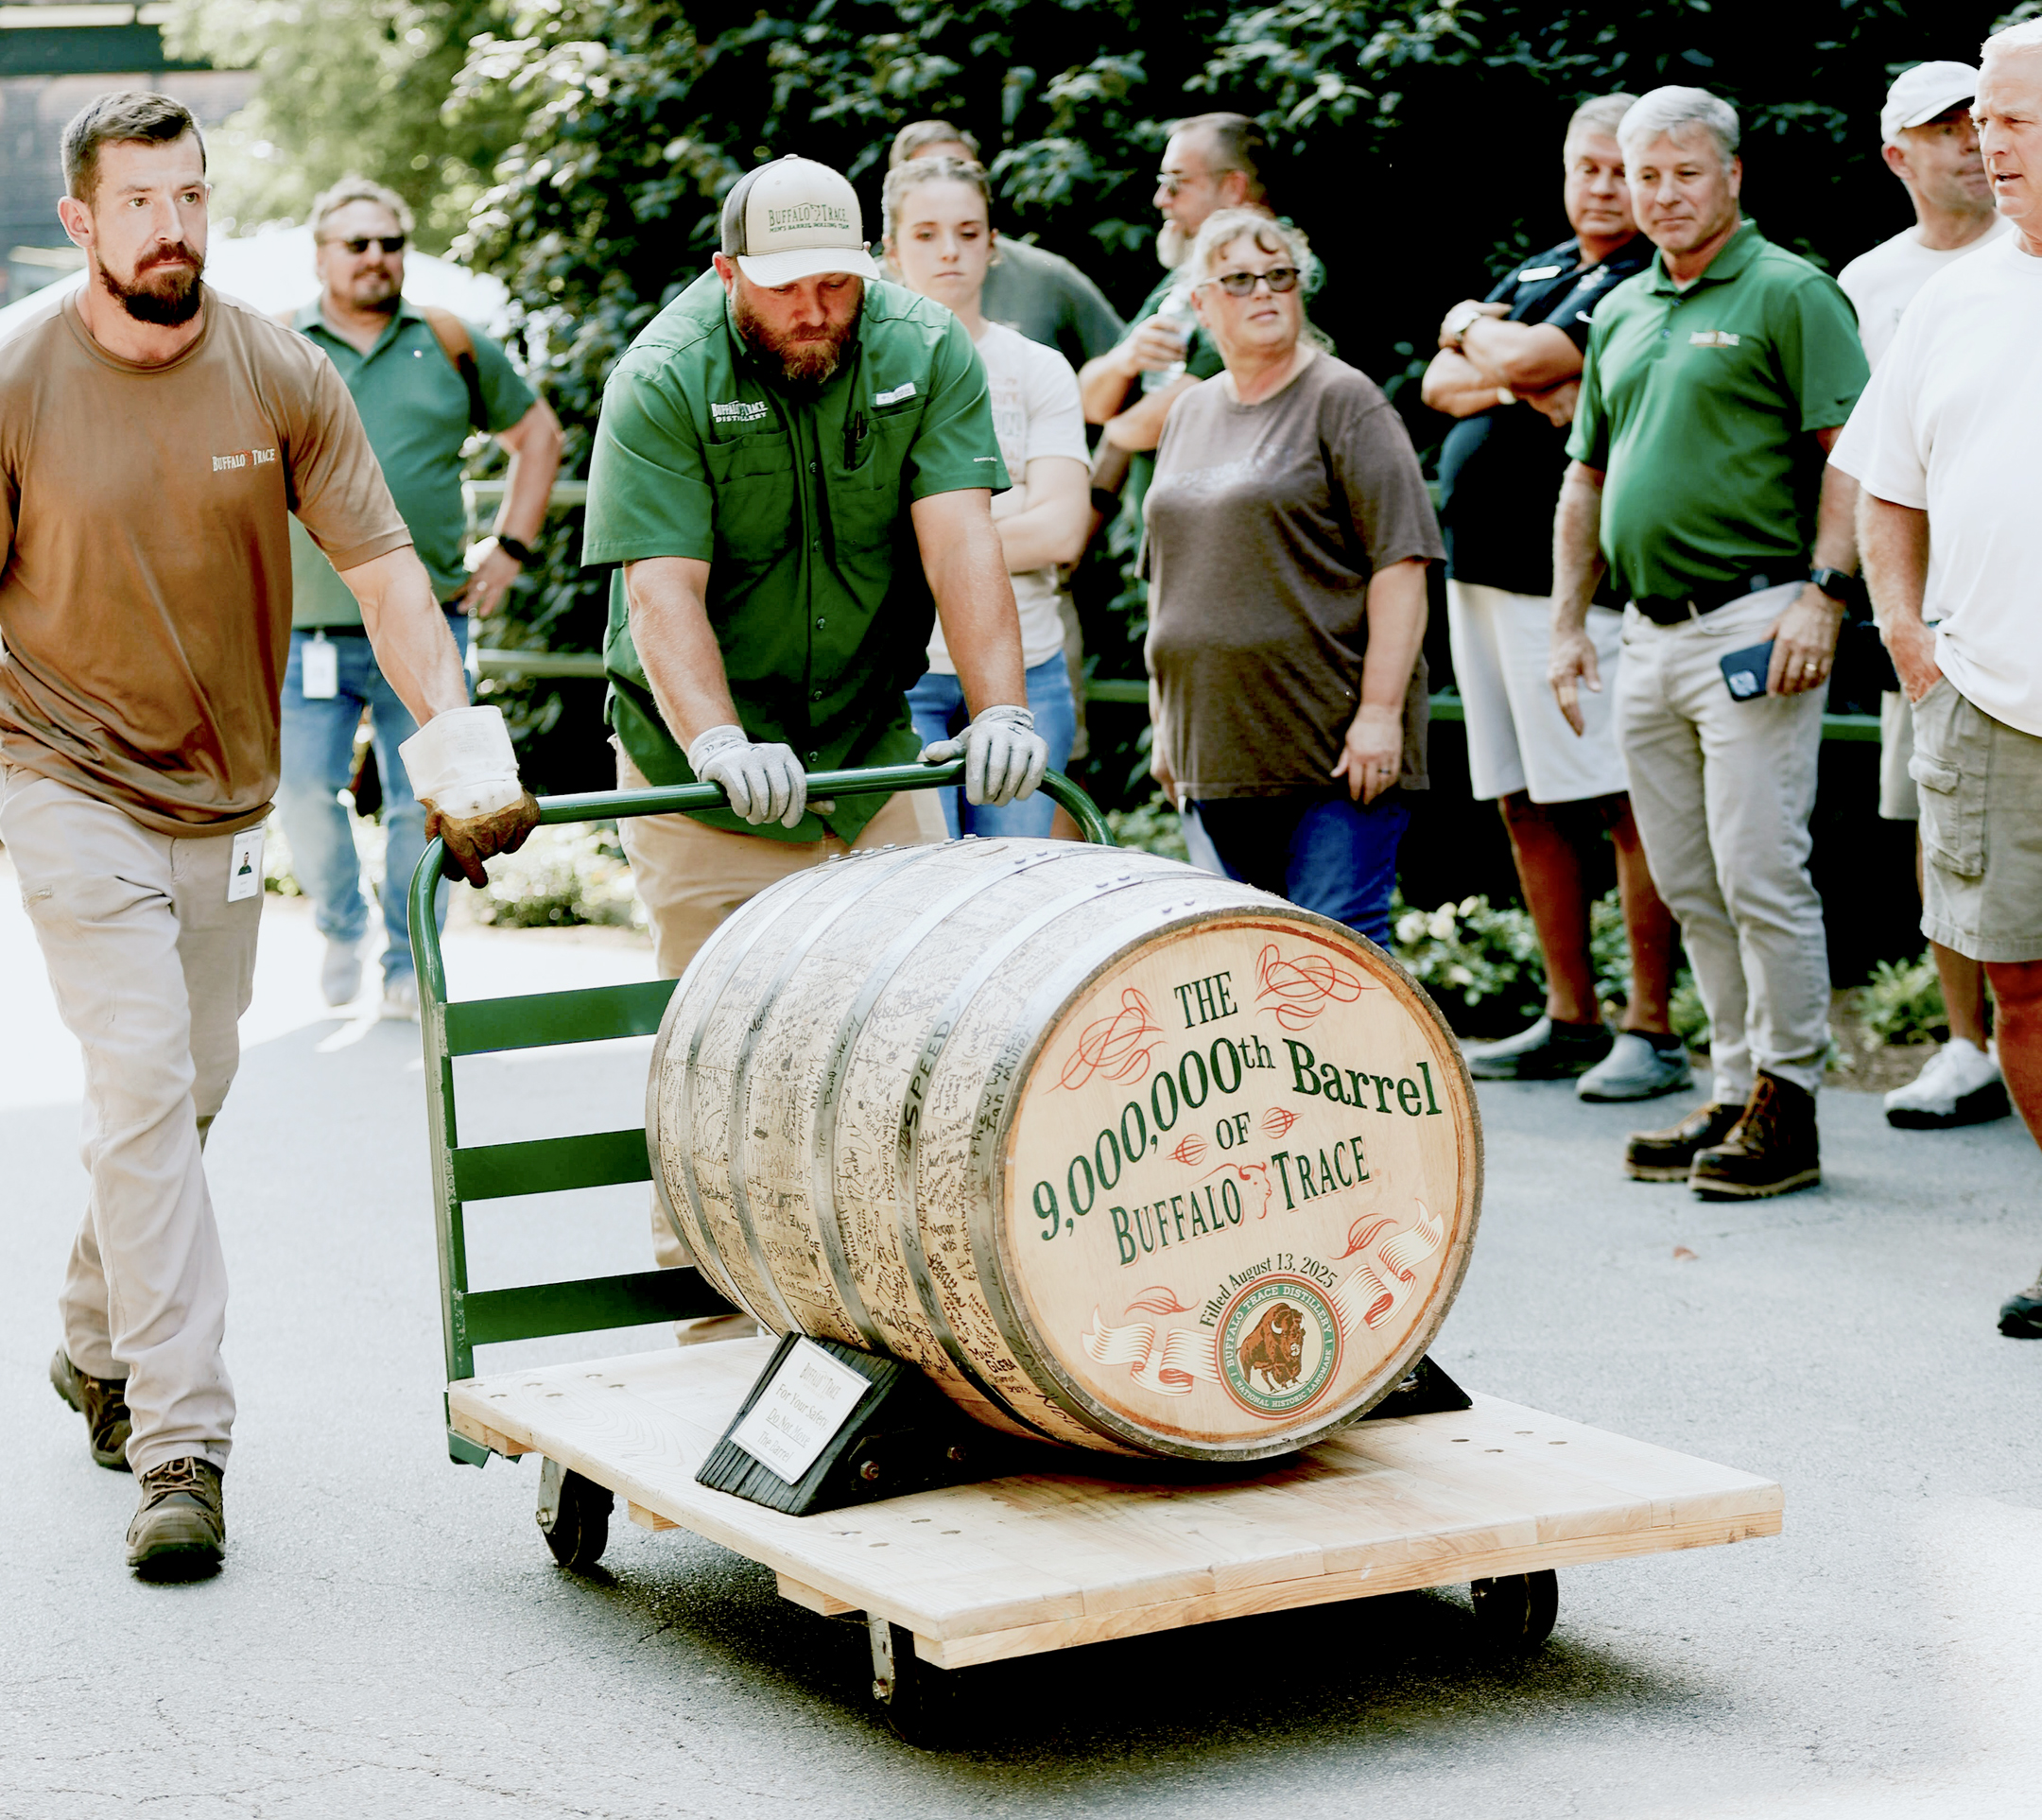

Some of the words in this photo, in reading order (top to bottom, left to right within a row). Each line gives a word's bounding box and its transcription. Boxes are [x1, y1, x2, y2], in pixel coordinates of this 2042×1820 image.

[768, 206, 810, 227] BUFFALO
[822, 203, 846, 222] TRACE
[711, 403, 740, 418] BUFFALO
[716, 411, 767, 424] DISTILLERY
[212, 453, 246, 472] BUFFALO
[251, 448, 275, 466] TRACE
[1174, 970, 1238, 1030] THE
[904, 997, 962, 1131] SPEEDY
[986, 1093, 1005, 1136] Ian
[1003, 1025, 1033, 1082] Miller
[1282, 1037, 1443, 1117] Barrel
[888, 1100, 902, 1153] Shelton
[1216, 1111, 1251, 1151] OF
[1110, 1178, 1242, 1267] BUFFALO
[1271, 1135, 1371, 1211] TRACE
[1200, 1283, 1232, 1328] Filled
[1228, 1257, 1272, 1291] August
[1276, 1253, 1296, 1273] 13,
[1299, 1256, 1339, 1289] 2025
[1225, 1310, 1245, 1368] BUFFALO
[1242, 1286, 1279, 1310] TRACE
[1282, 1286, 1332, 1334] DISTILLERY
[1235, 1379, 1270, 1408] NATIONAL
[1272, 1391, 1307, 1408] HISTORIC
[1307, 1348, 1332, 1394] LANDMARK
[767, 1407, 779, 1424] Do
[779, 1415, 795, 1433] Not
[790, 1424, 811, 1447] Move
[775, 1383, 792, 1401] For
[789, 1392, 809, 1413] Your
[805, 1405, 829, 1431] Safety,
[757, 1430, 771, 1448] The
[770, 1437, 795, 1464] Barrel
